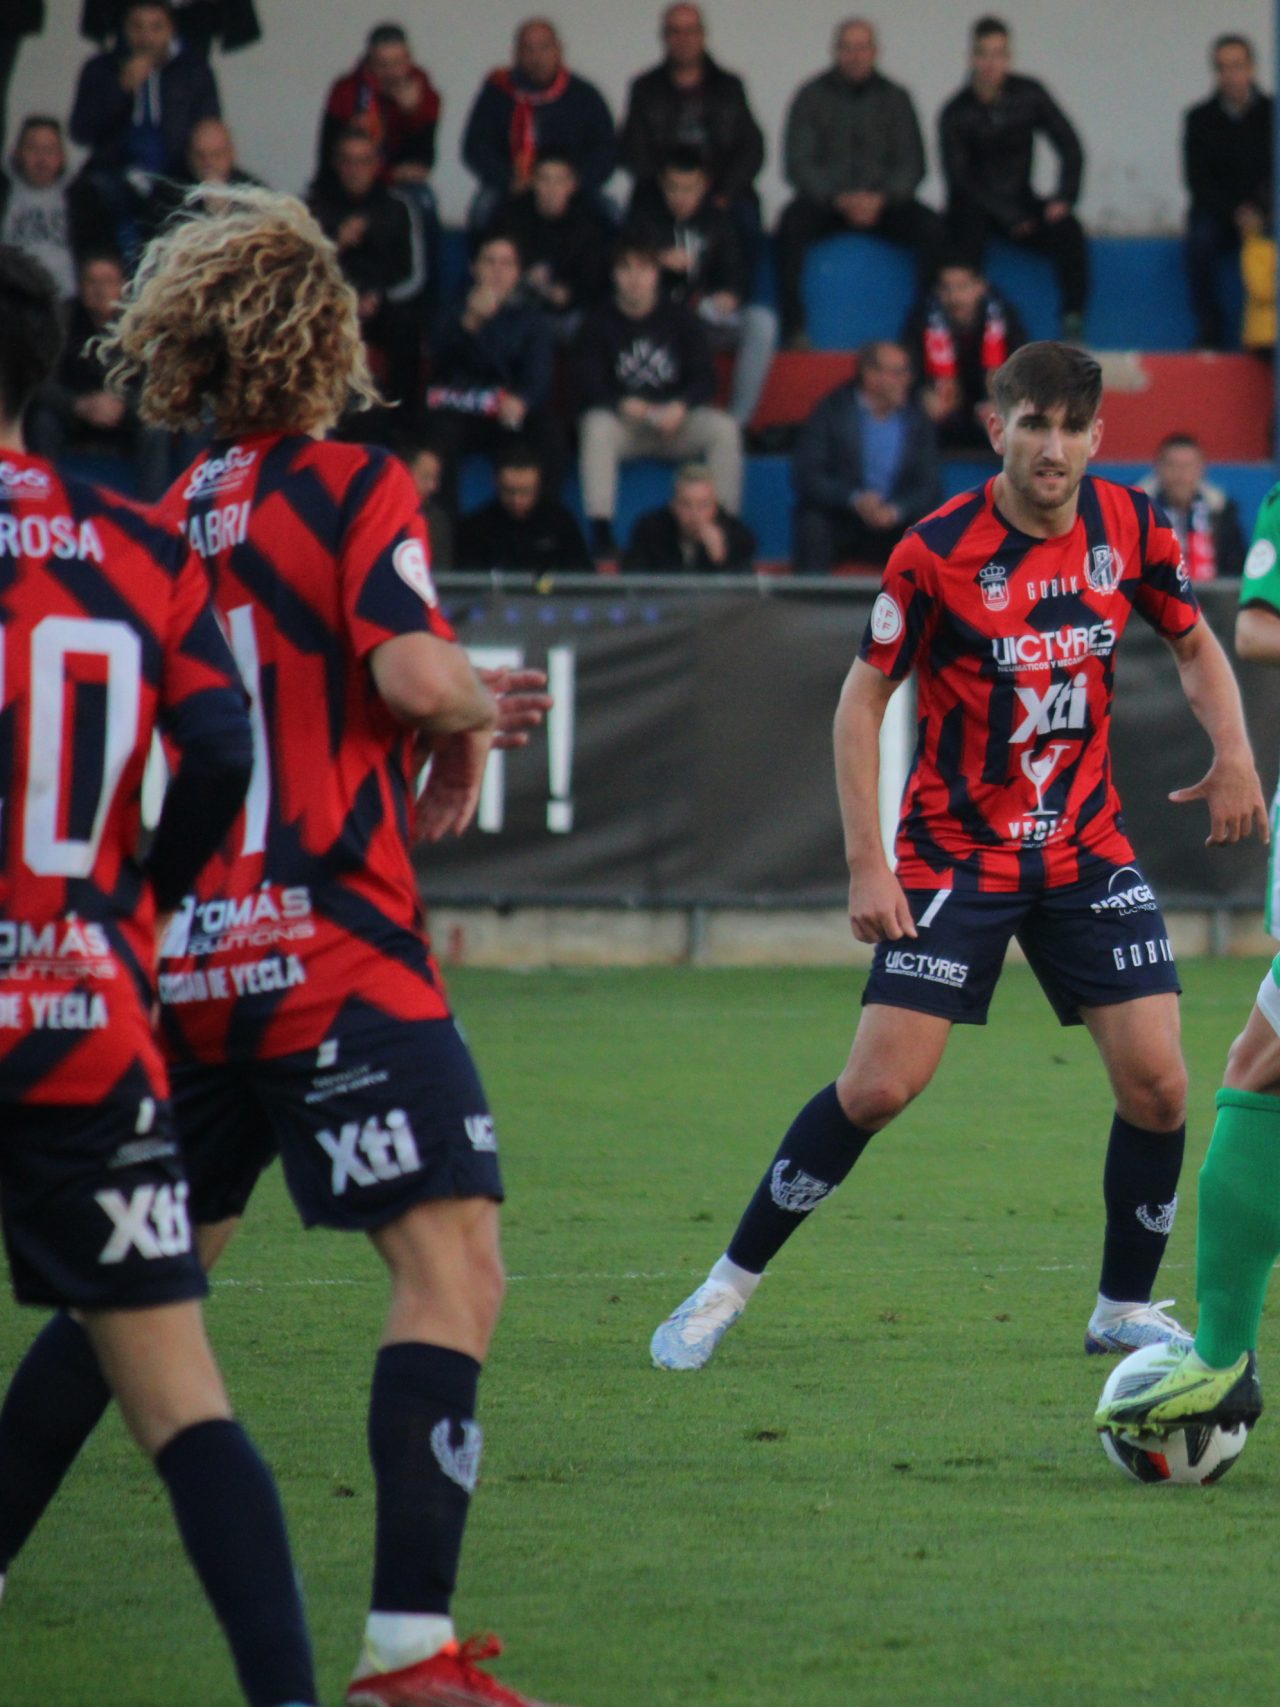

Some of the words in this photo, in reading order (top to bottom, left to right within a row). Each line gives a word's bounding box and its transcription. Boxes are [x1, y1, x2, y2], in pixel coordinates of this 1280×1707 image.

[1008, 672, 1089, 744] Xti
[230, 953, 305, 997] YECLA
[315, 1109, 422, 1197] Xti
[94, 1179, 192, 1265] Xti
